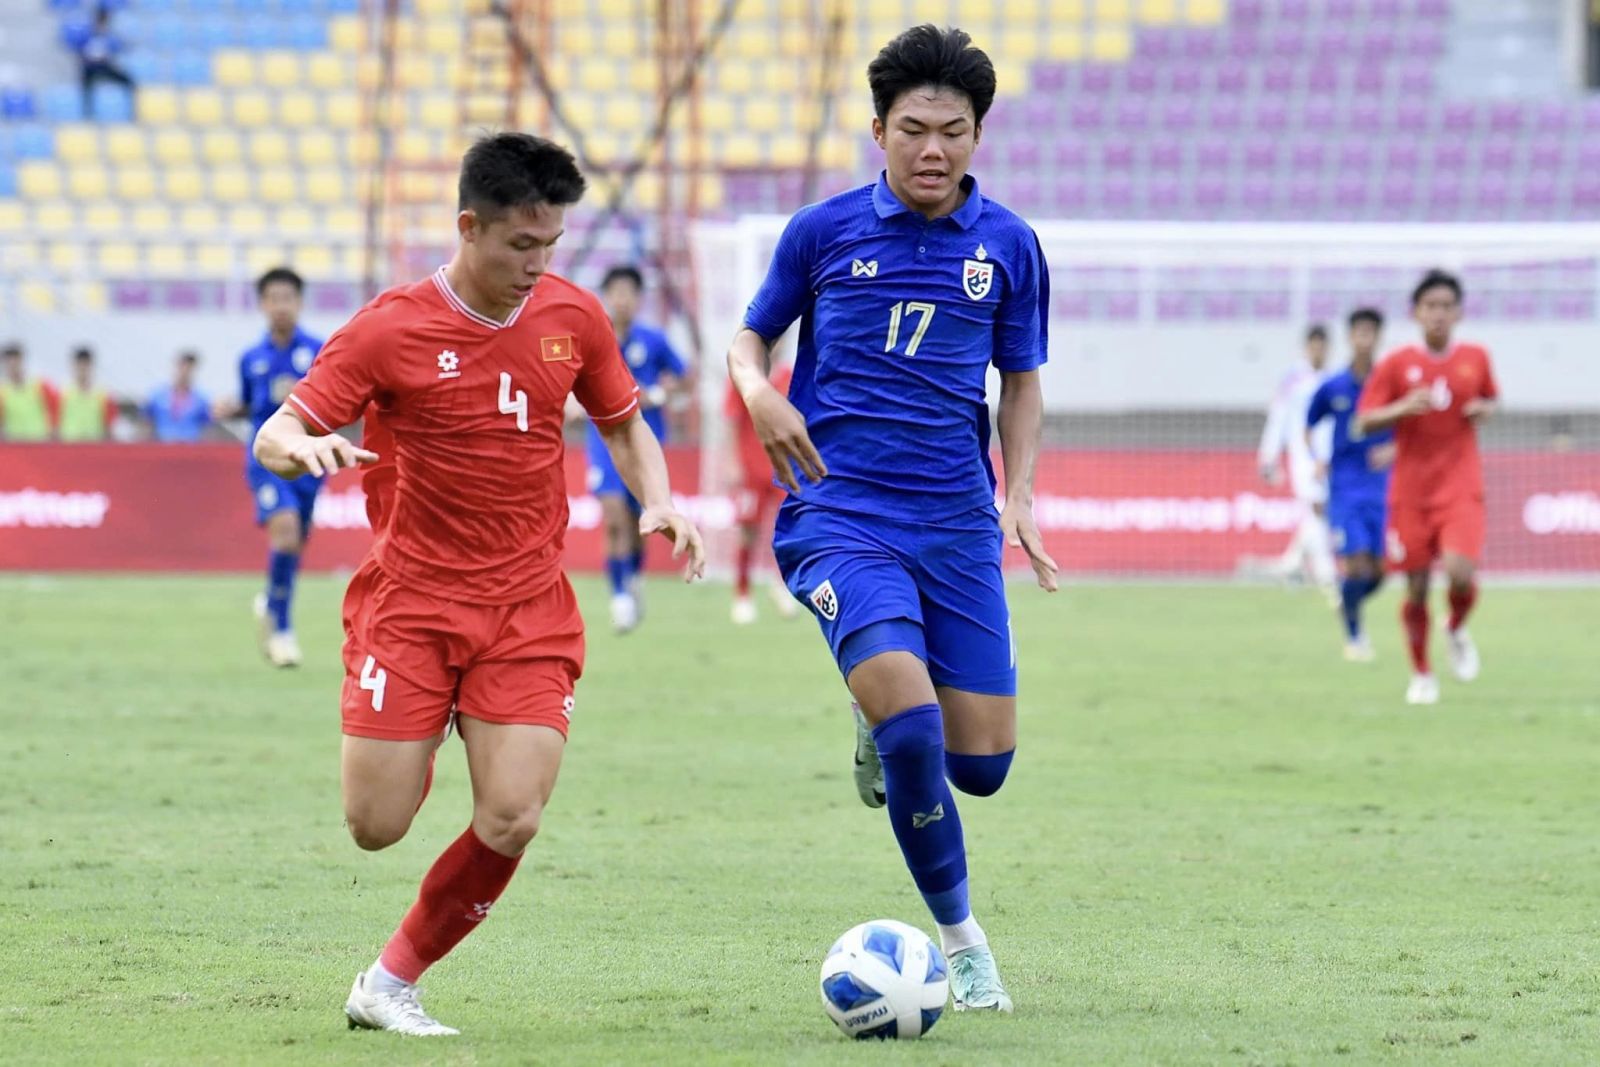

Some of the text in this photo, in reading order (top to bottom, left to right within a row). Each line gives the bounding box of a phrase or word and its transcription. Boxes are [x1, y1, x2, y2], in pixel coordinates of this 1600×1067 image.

[884, 301, 936, 358] 17
[498, 371, 529, 432] 4
[359, 654, 387, 712] 4
